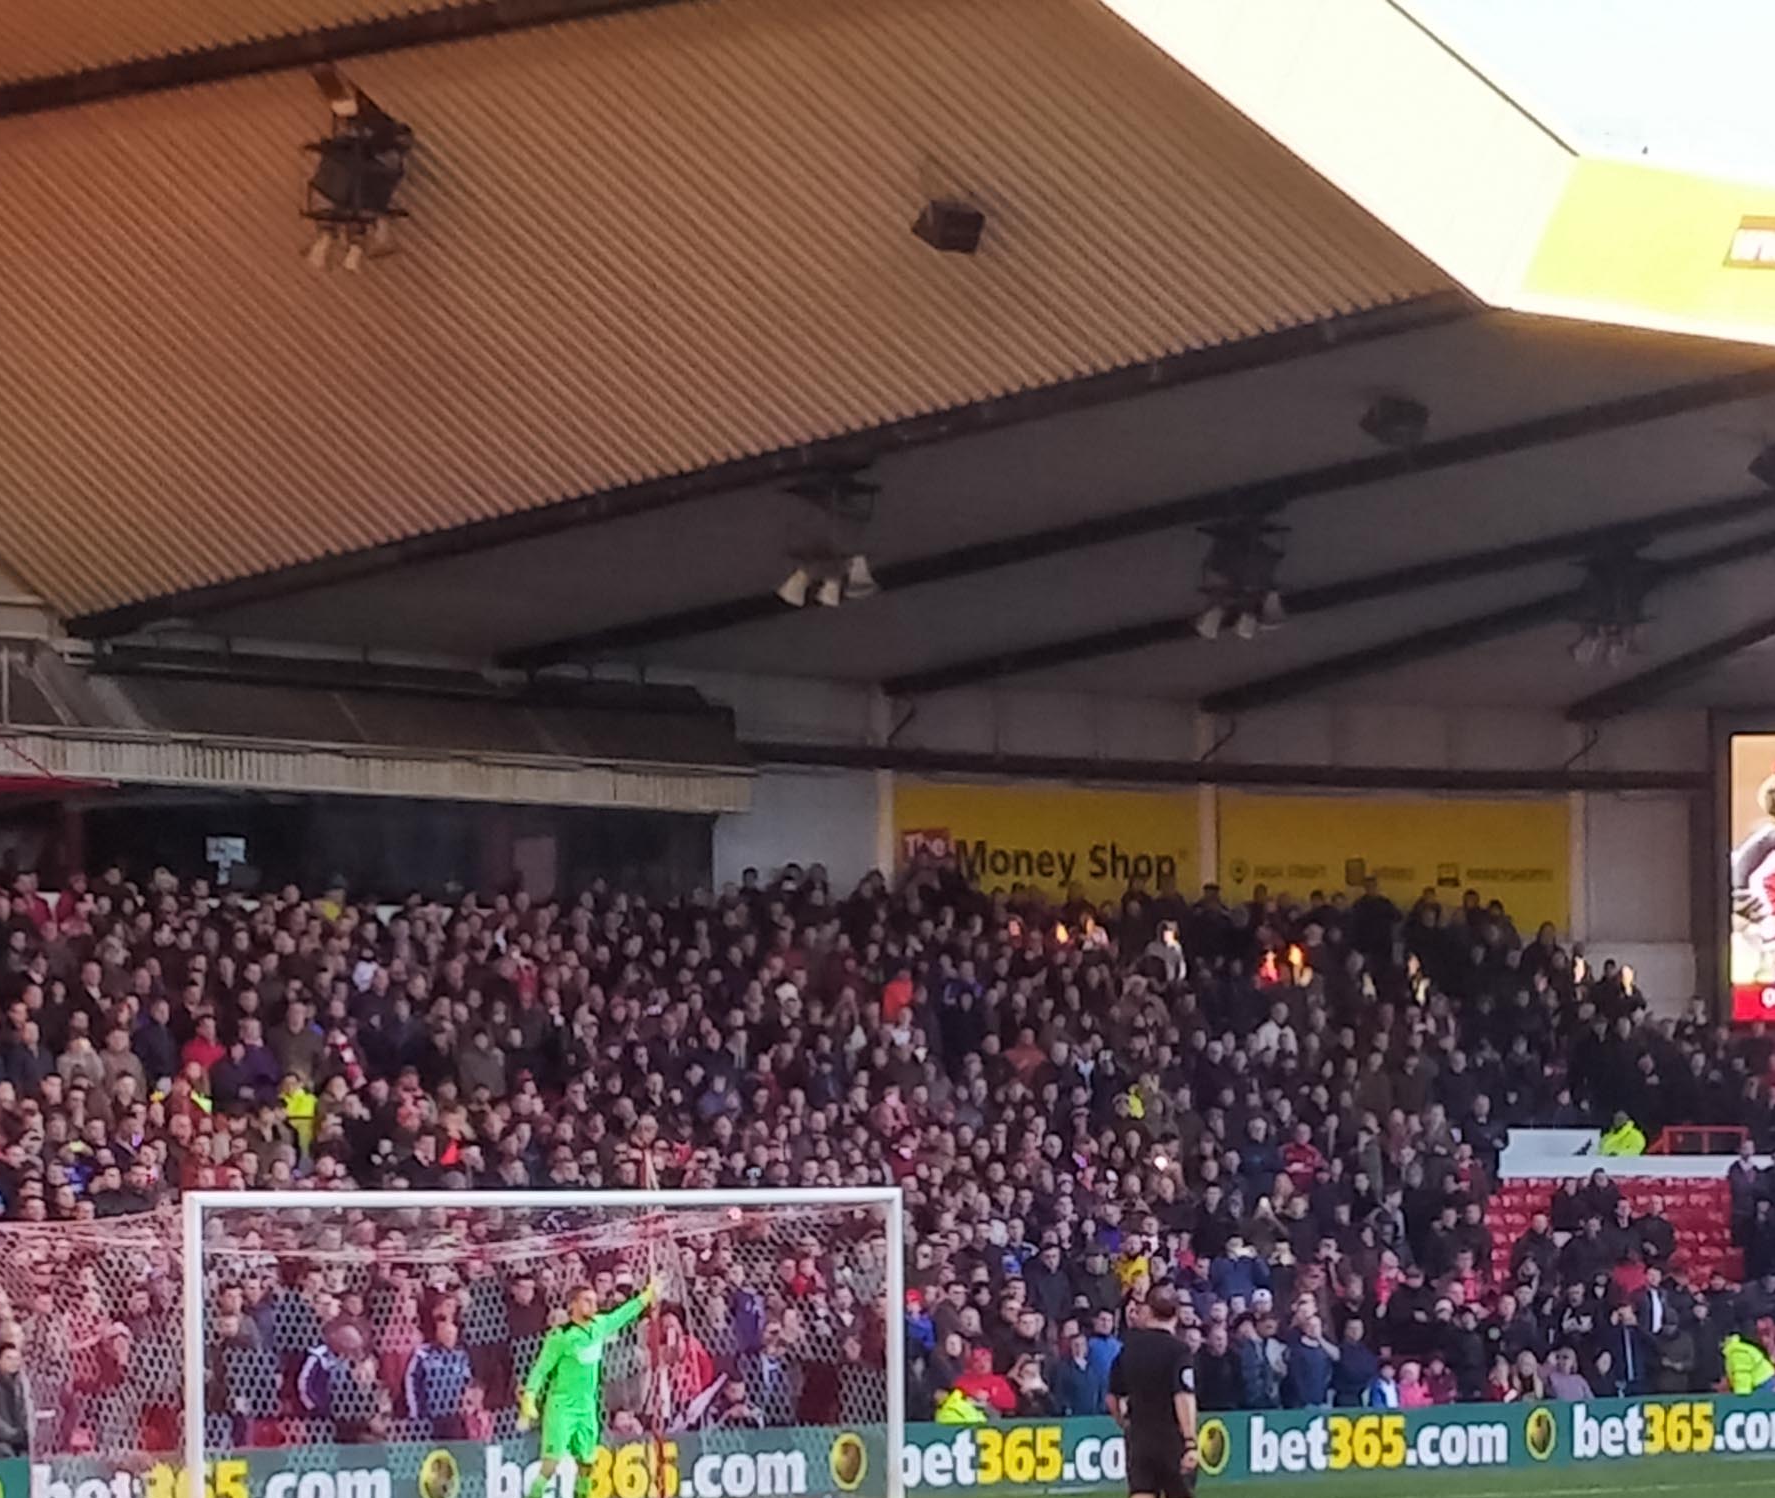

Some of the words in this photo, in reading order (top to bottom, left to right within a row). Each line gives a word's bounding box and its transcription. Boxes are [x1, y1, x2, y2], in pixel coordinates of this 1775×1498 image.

[954, 840, 1075, 887] Money
[1088, 842, 1176, 889] Shop
[1249, 1415, 1508, 1473] bet365.com
